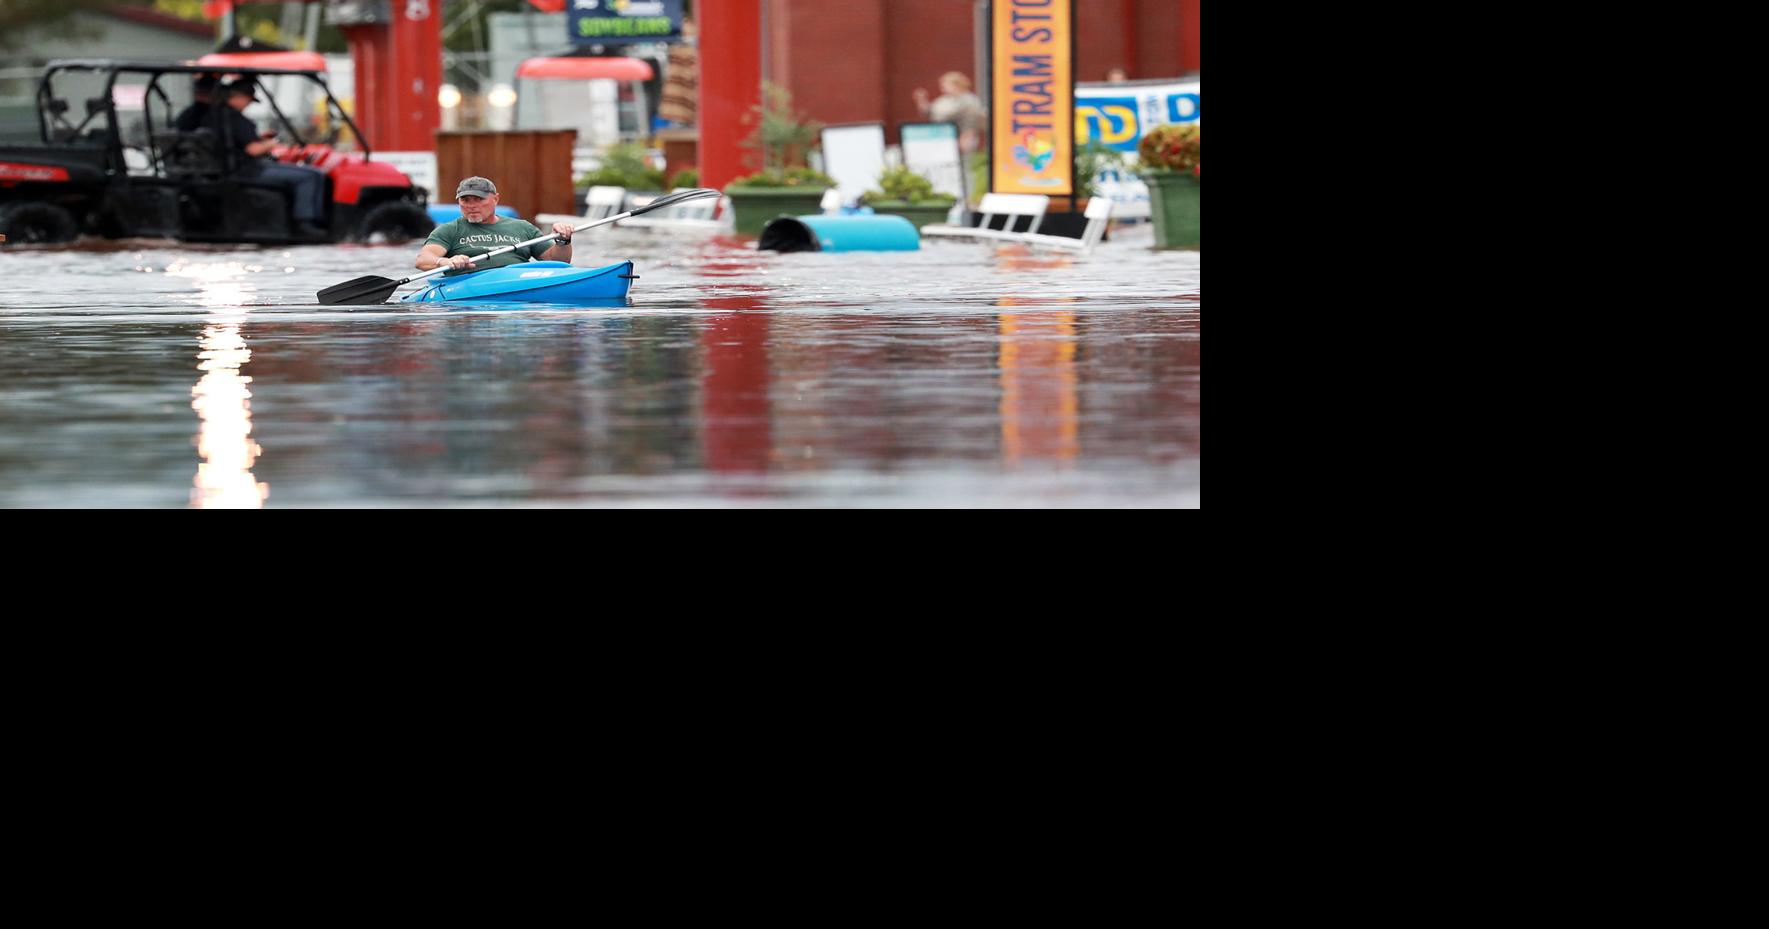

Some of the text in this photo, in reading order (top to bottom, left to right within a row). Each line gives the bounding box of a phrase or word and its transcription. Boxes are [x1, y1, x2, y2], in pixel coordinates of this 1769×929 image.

[1012, 54, 1052, 133] TRAM
[459, 234, 521, 245] CACTUS JACKS
